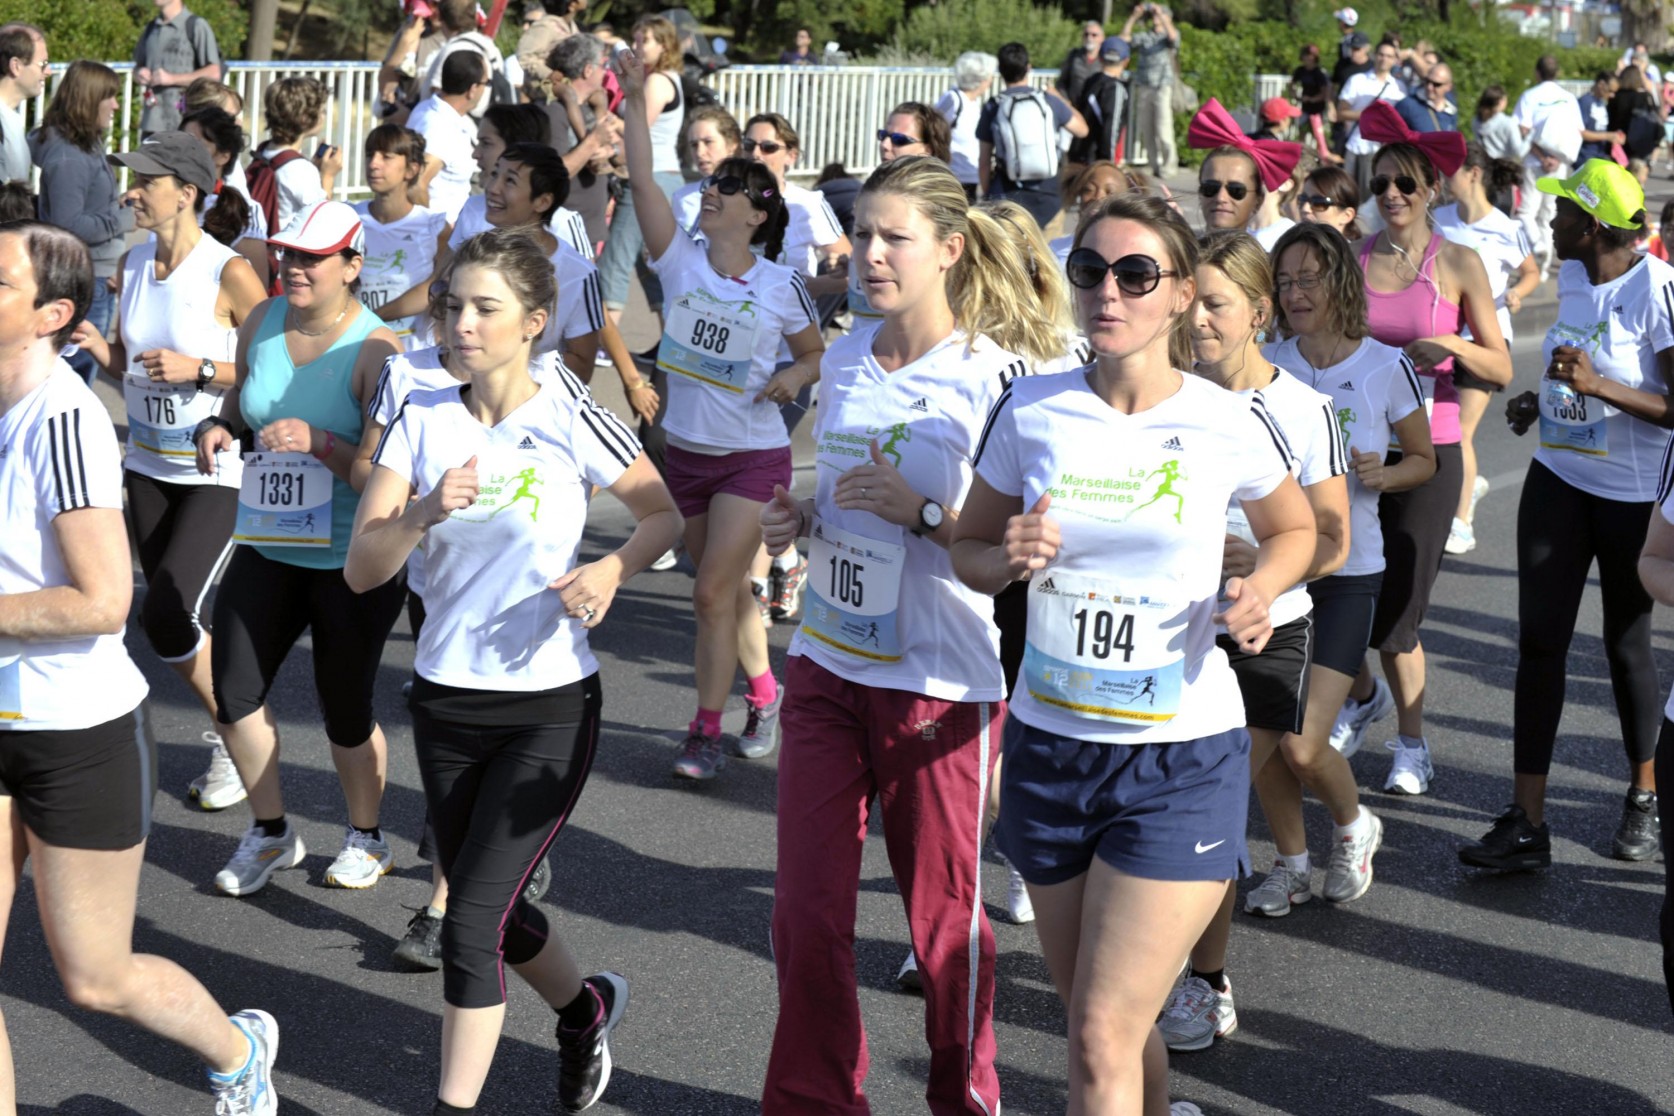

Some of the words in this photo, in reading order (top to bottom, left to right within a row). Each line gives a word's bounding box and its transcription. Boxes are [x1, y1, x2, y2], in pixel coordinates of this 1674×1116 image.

[691, 319, 730, 354] 938
[144, 395, 175, 425] 176
[866, 425, 879, 435] La
[826, 442, 865, 458] Femmes
[490, 473, 505, 483] La
[1129, 467, 1145, 477] La
[259, 472, 304, 506] 1331
[1060, 473, 1141, 491] Marseillaise
[1072, 489, 1134, 504] Femmes
[830, 555, 864, 607] 105
[1074, 608, 1135, 663] 194
